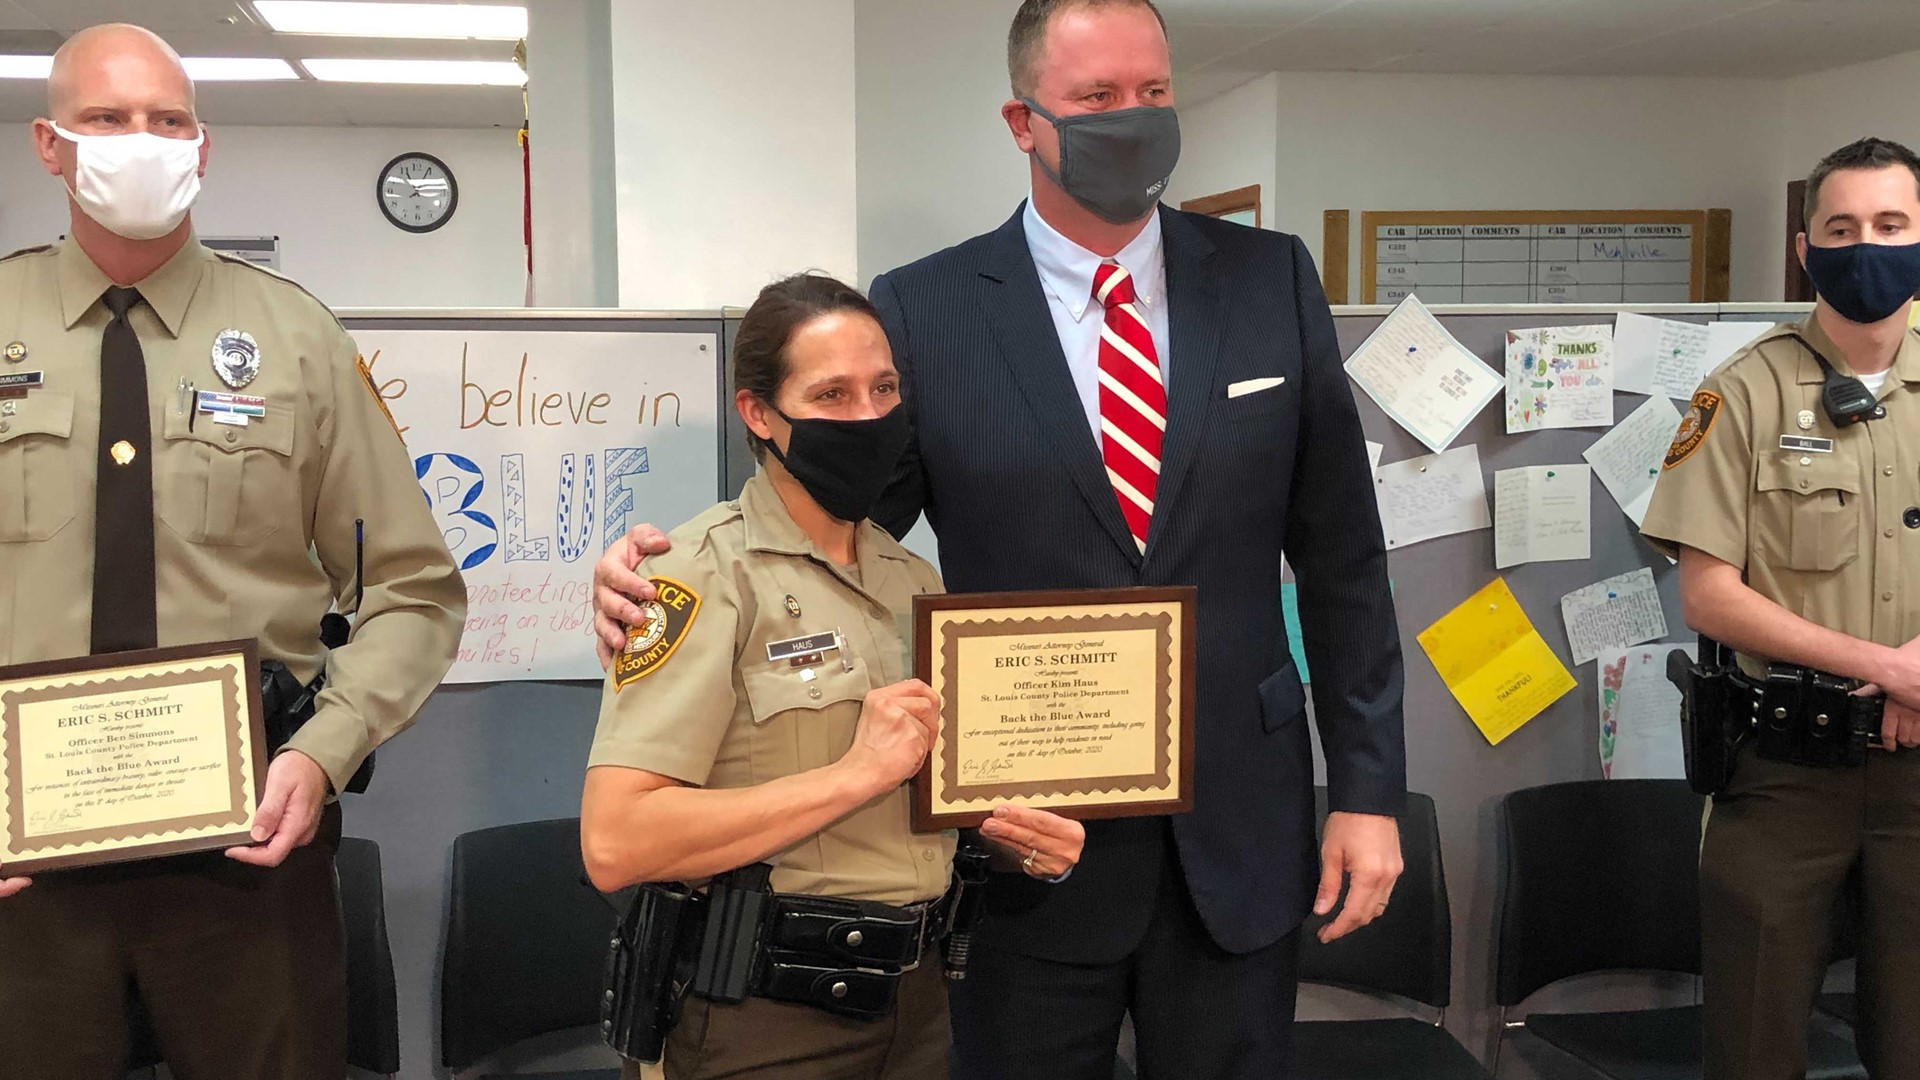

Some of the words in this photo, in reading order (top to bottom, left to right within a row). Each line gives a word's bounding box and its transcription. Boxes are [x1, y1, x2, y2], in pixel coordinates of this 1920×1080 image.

[1387, 228, 1405, 236] CAR
[1418, 228, 1461, 236] LOCATION
[1471, 227, 1520, 236] COMMENTS
[1548, 227, 1566, 235] CAR
[1580, 227, 1623, 235] LOCATION
[1634, 226, 1682, 235] COMMENTS
[1557, 342, 1597, 355] THANKS
[1577, 358, 1599, 370] ALL
[460, 341, 611, 430] believe
[637, 381, 681, 428] in
[1560, 375, 1581, 387] YOU
[1675, 428, 1703, 456] COUNTY
[1799, 440, 1813, 448] BALL
[656, 583, 692, 611] ICE
[516, 615, 539, 629] on
[792, 639, 814, 651] HAUS
[1008, 642, 1041, 651] Missouri
[1042, 641, 1073, 650] Attorney
[1074, 640, 1105, 650] General
[625, 637, 670, 671] COUNTY
[994, 656, 1031, 668] ERIC
[1034, 655, 1047, 666] S.
[1051, 652, 1118, 666] SCHMITT
[1014, 681, 1048, 690] Officer
[1051, 680, 1071, 688] Kim
[1073, 679, 1098, 687] Haus
[106, 699, 137, 708] Attorney
[138, 694, 169, 705] General
[980, 694, 993, 702] St.
[994, 694, 1018, 702] Louis
[1020, 693, 1051, 701] County
[1053, 691, 1079, 699] Police
[1080, 689, 1129, 698] Department
[57, 714, 94, 728] ERIC
[98, 713, 110, 723] S.
[114, 704, 183, 721] SCHMITT
[1000, 714, 1027, 723] Back
[1029, 713, 1047, 722] the
[1050, 712, 1074, 721] Blue
[1077, 709, 1111, 720] Award
[68, 738, 104, 747] Officer
[106, 735, 126, 743] Ben
[128, 729, 175, 740] Simmons
[982, 728, 1016, 737] exceptional
[59, 750, 83, 758] Louis
[85, 746, 116, 755] County
[119, 742, 145, 751] Police
[147, 736, 198, 747] Department
[1053, 736, 1065, 745] help
[1036, 749, 1048, 758] day
[1085, 745, 1103, 754] 2020
[66, 767, 93, 777] Back
[96, 765, 114, 773] the
[117, 761, 142, 771] Blue
[144, 756, 180, 767] Award
[156, 789, 175, 798] 2020
